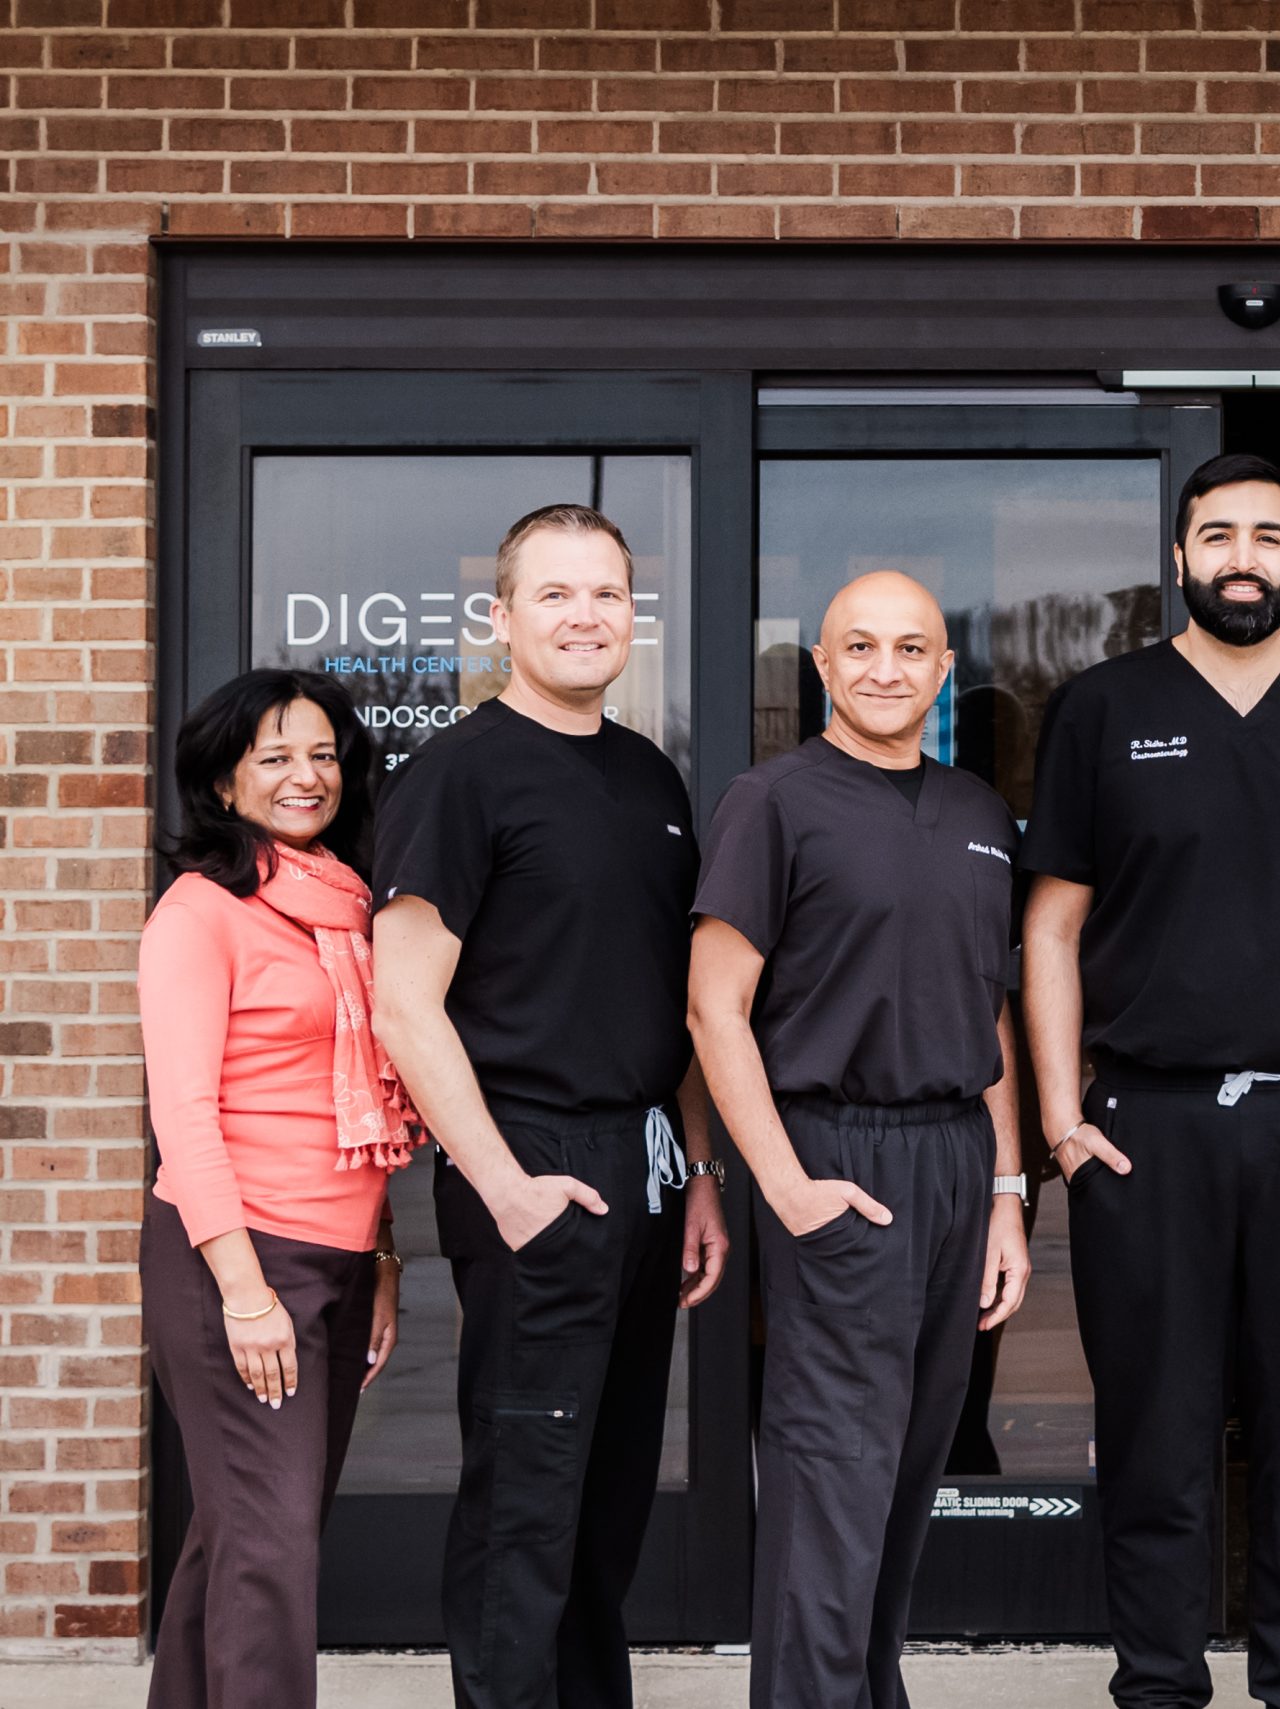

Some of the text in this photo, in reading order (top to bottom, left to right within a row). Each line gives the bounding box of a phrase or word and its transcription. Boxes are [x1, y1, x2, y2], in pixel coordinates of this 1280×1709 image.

[203, 333, 256, 343] STANLEY
[325, 657, 405, 673] HEALTH
[412, 657, 493, 673] CENTER
[963, 1497, 1001, 1507] SLIDING
[1002, 1497, 1029, 1507] DOOR
[942, 1507, 976, 1517] without
[977, 1508, 1014, 1519] warning
